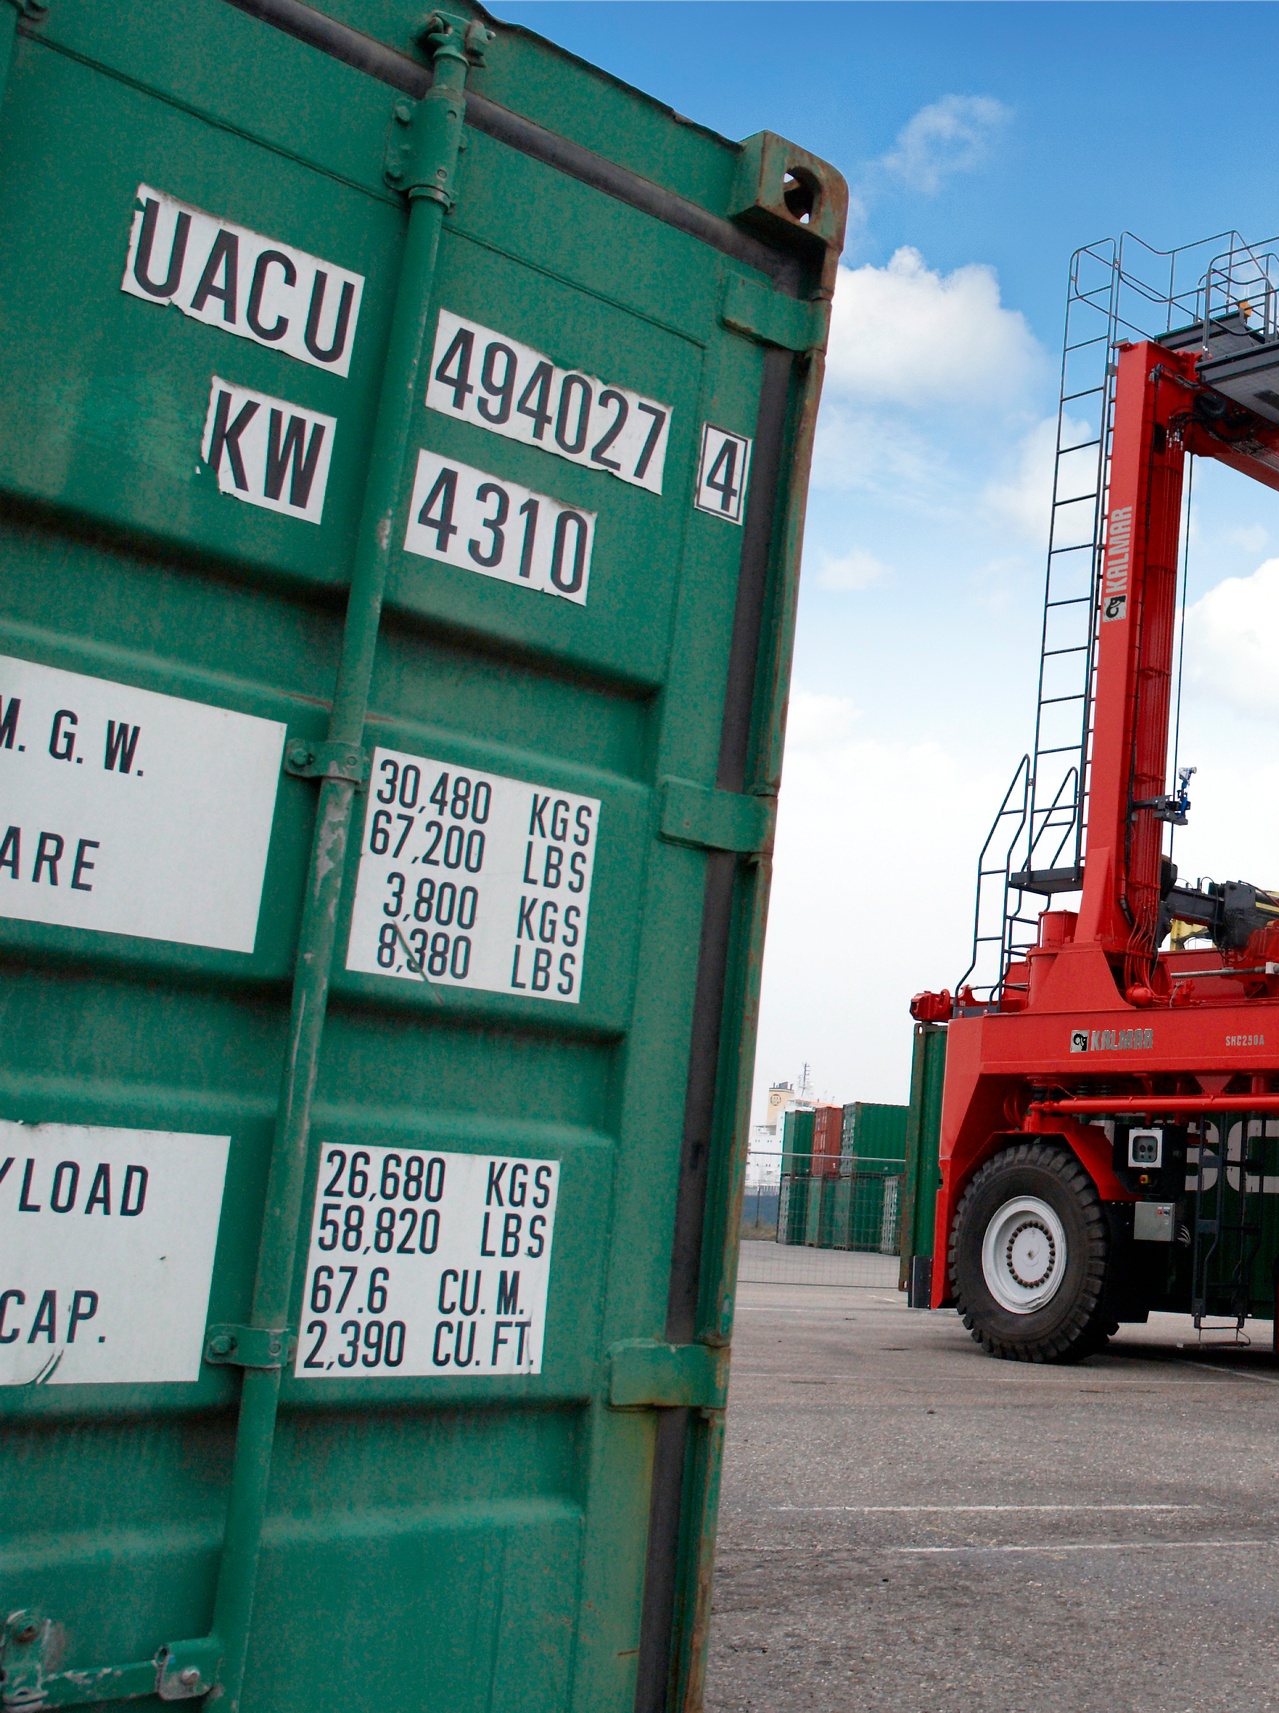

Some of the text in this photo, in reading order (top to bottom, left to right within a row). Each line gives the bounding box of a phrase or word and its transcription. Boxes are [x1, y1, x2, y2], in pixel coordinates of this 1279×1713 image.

[134, 198, 738, 512] UACU 494027 4
[210, 390, 590, 595] KW 4310
[1105, 506, 1133, 594] KALMAR
[49, 709, 84, 764] G.
[104, 720, 144, 777] W.
[377, 759, 593, 847] 30,480 KGS
[0, 825, 100, 892] ARE
[370, 811, 587, 894] 67,200 LBS
[382, 872, 581, 948] 3,800 KGS
[377, 922, 577, 996] 8,380 LBS
[1091, 1028, 1153, 1051] KALMAR
[325, 1150, 552, 1210] 26,680 KGS
[318, 1203, 546, 1259] 58,820 LBS
[0, 1289, 106, 1344] CAP.
[310, 1265, 390, 1314] 67.6
[303, 1319, 407, 1371] 2,390
